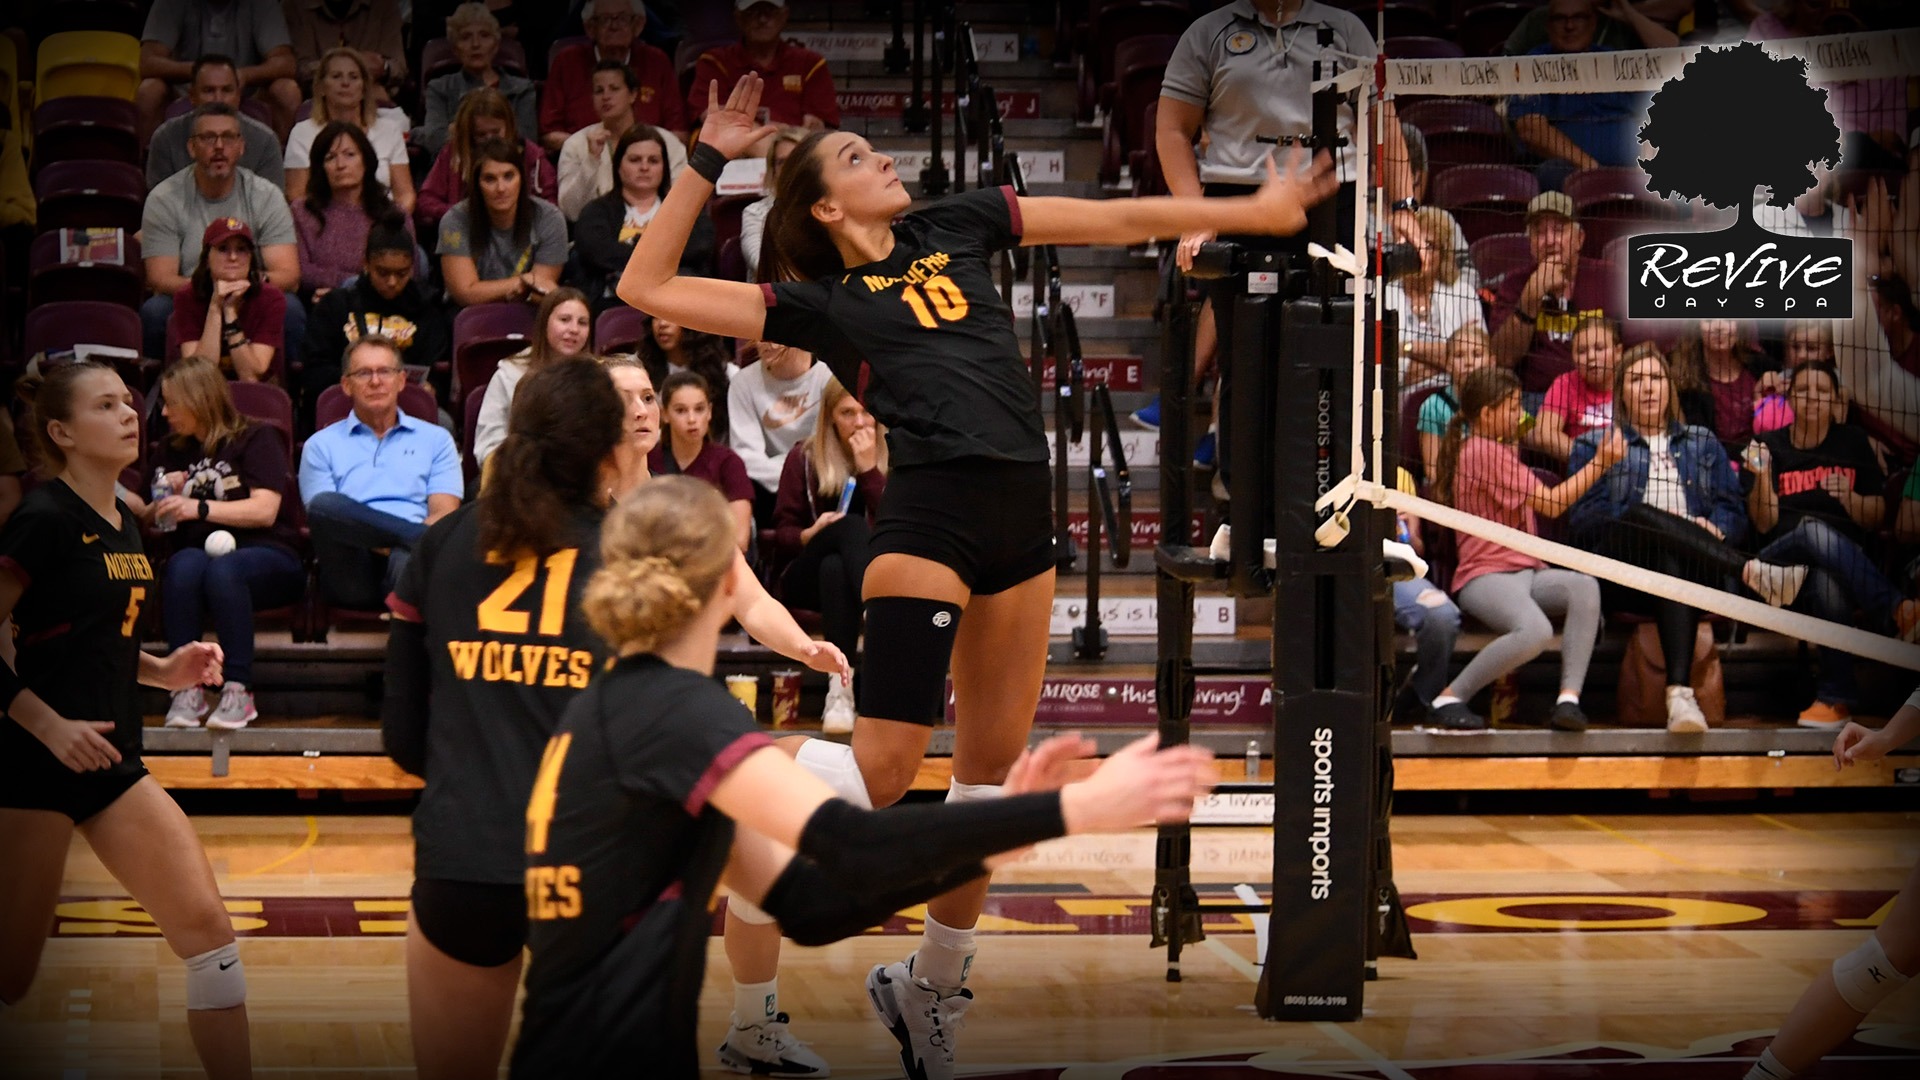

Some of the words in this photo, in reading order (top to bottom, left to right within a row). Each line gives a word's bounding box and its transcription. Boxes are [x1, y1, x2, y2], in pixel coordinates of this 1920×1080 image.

[1004, 41, 1014, 54] K
[1026, 99, 1036, 114] J
[1049, 159, 1060, 173] H
[901, 275, 970, 329] 10
[1126, 365, 1138, 383] E
[477, 548, 579, 635] 21
[121, 587, 146, 638] 5
[1218, 607, 1230, 623] B
[447, 640, 594, 689] WOLVES
[1195, 685, 1246, 716] iving!
[1310, 727, 1335, 804] sports
[1308, 807, 1333, 900] imports
